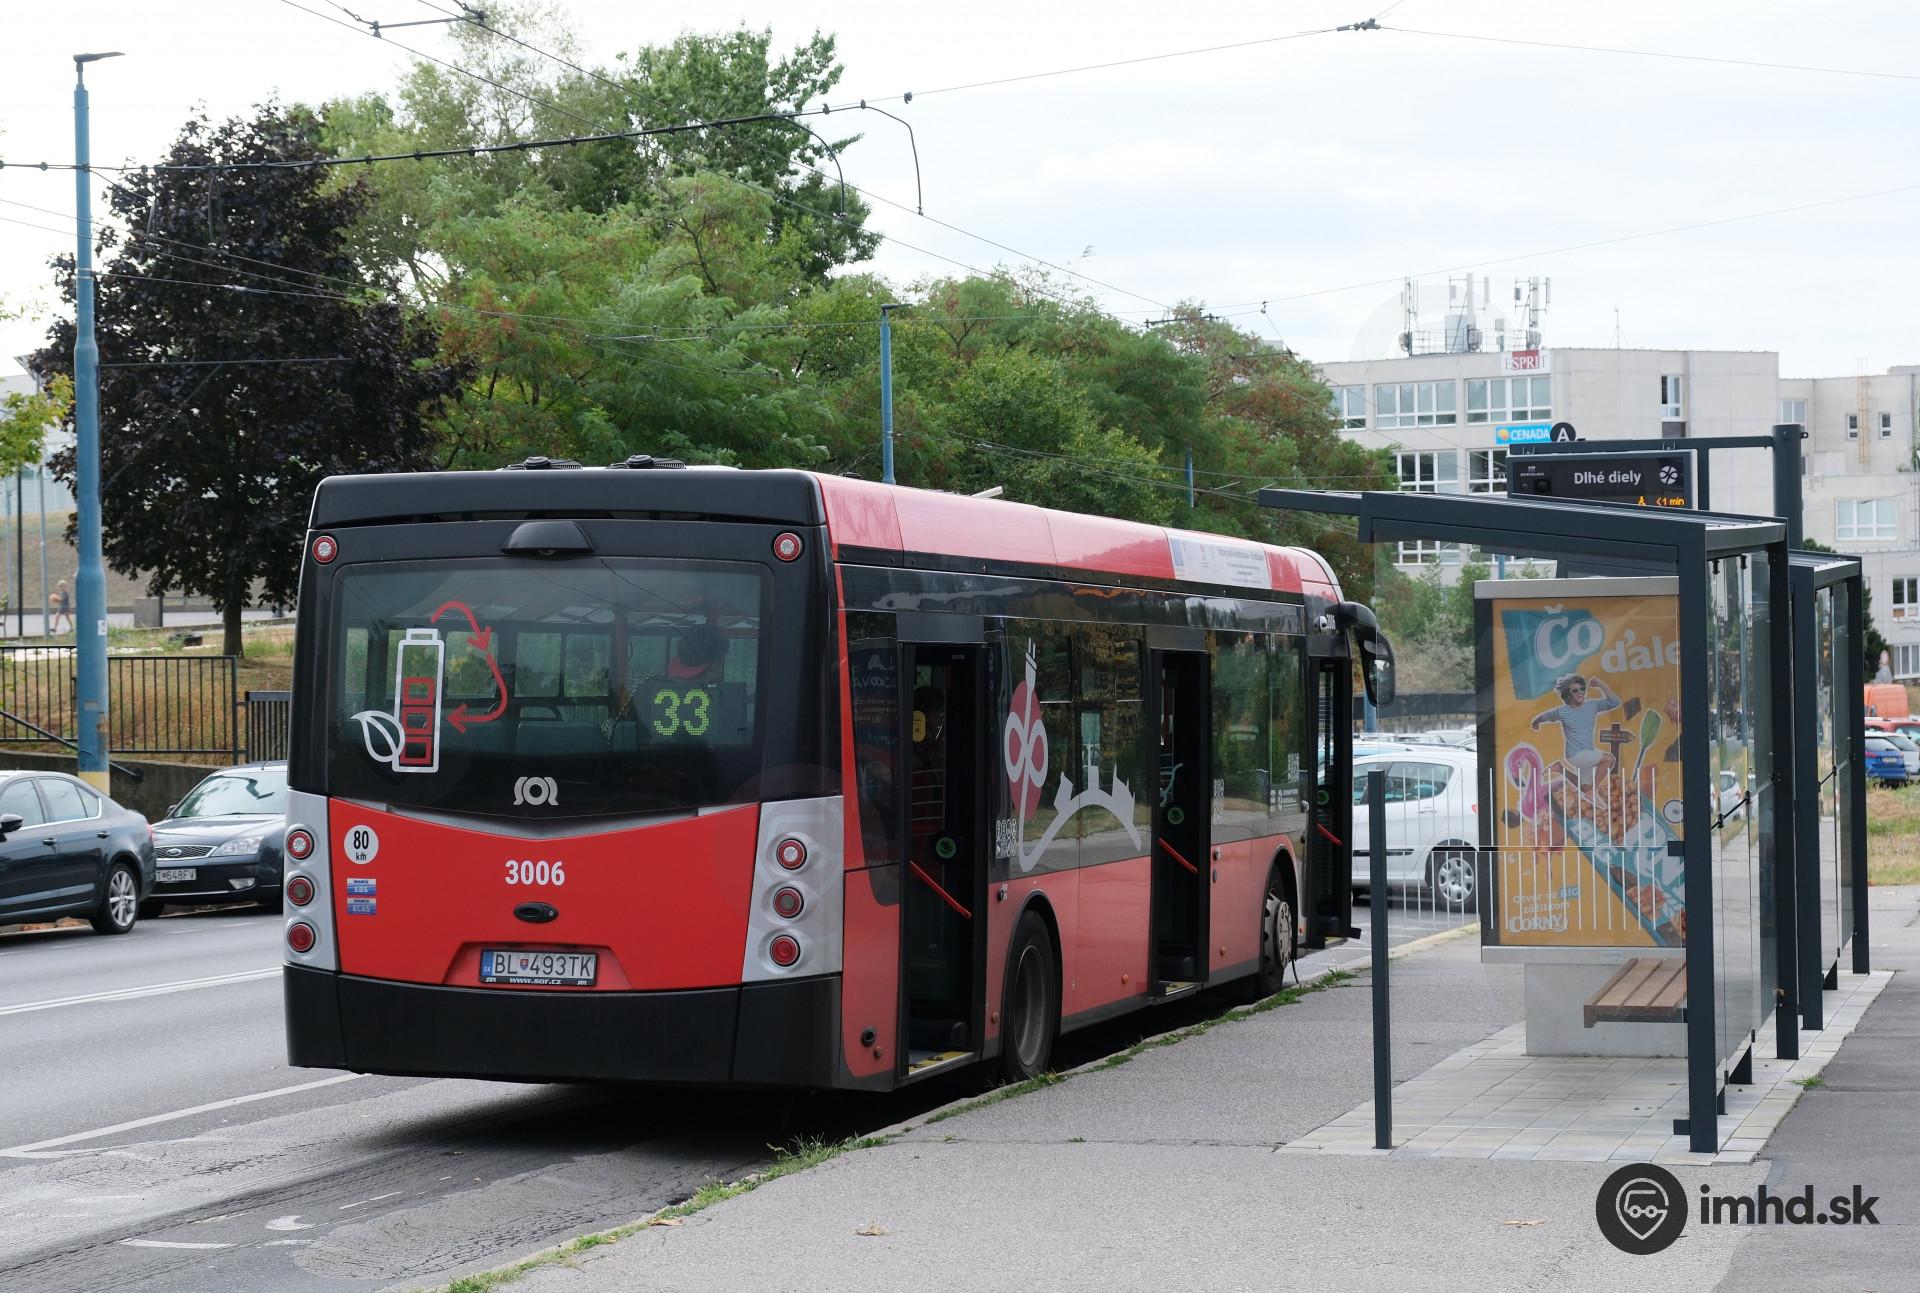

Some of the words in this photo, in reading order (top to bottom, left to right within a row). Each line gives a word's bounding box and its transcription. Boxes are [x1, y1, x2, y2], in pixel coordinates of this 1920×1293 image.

[1505, 355, 1545, 370] ESPRIT
[1510, 428, 1551, 441] CENADA
[1556, 427, 1570, 442] A
[1573, 470, 1605, 485] Dlhé
[1608, 470, 1642, 486] diely
[1535, 603, 1603, 669] Čo
[654, 689, 710, 736] 33
[353, 830, 369, 850] 80
[504, 859, 565, 886] 3006
